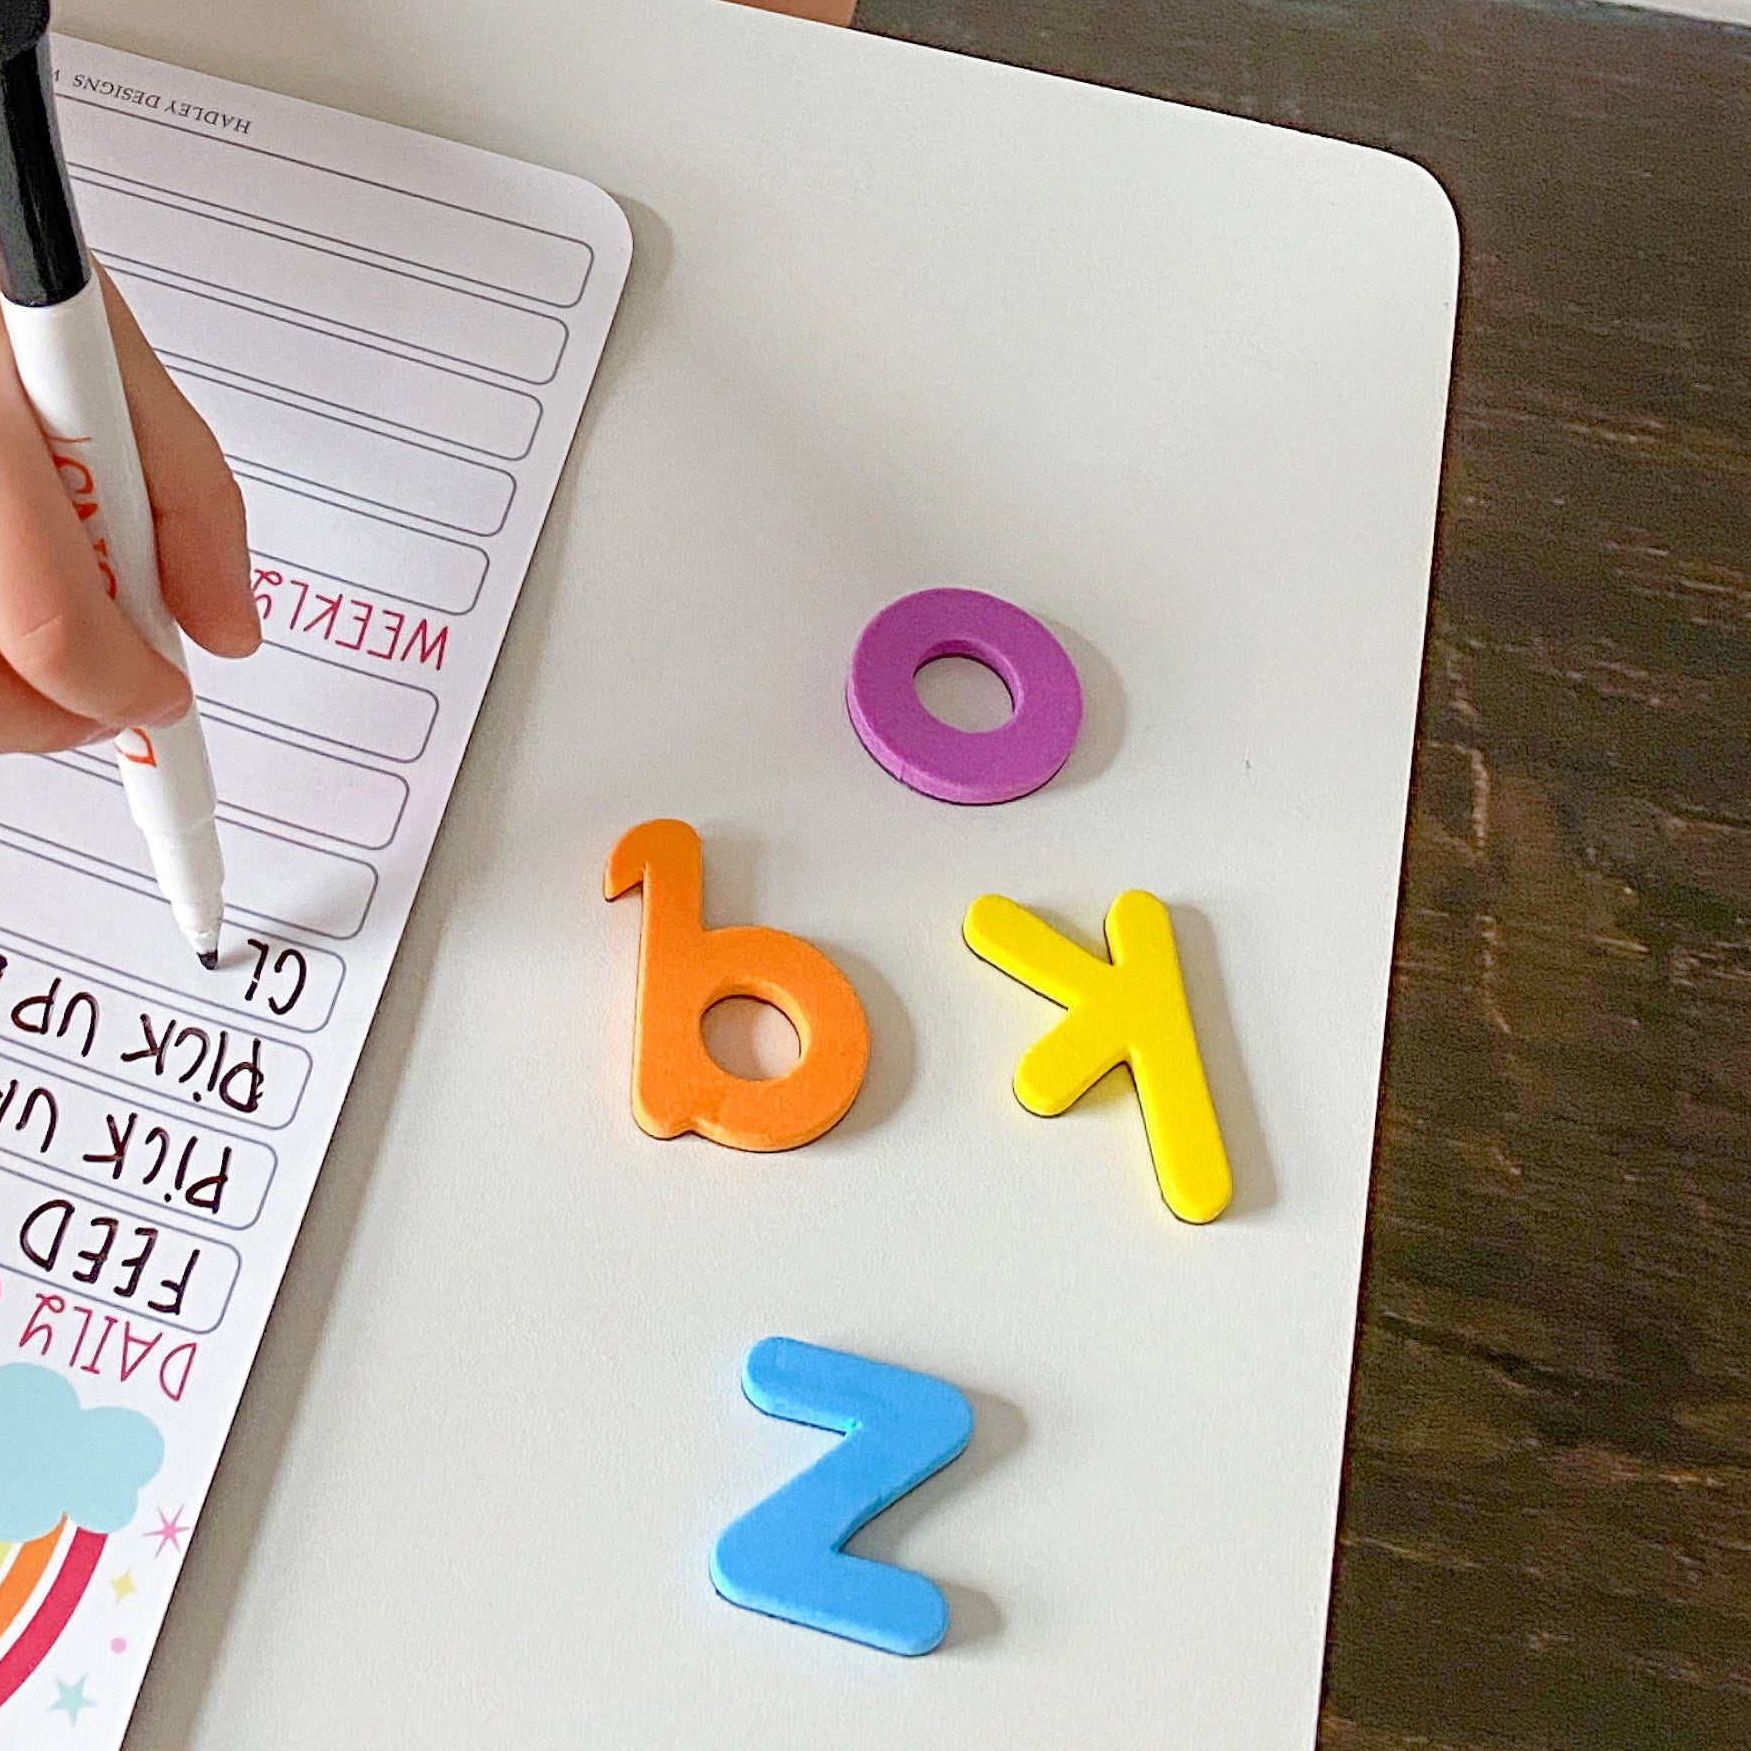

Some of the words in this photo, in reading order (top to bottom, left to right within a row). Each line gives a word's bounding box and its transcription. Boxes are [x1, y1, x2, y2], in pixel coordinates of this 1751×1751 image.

[72, 75, 161, 109] DESIGNS
[164, 100, 252, 134] HADLEY
[11, 977, 99, 1057] UP
[19, 1198, 200, 1316] FEED
[20, 1292, 198, 1402] DAILY
